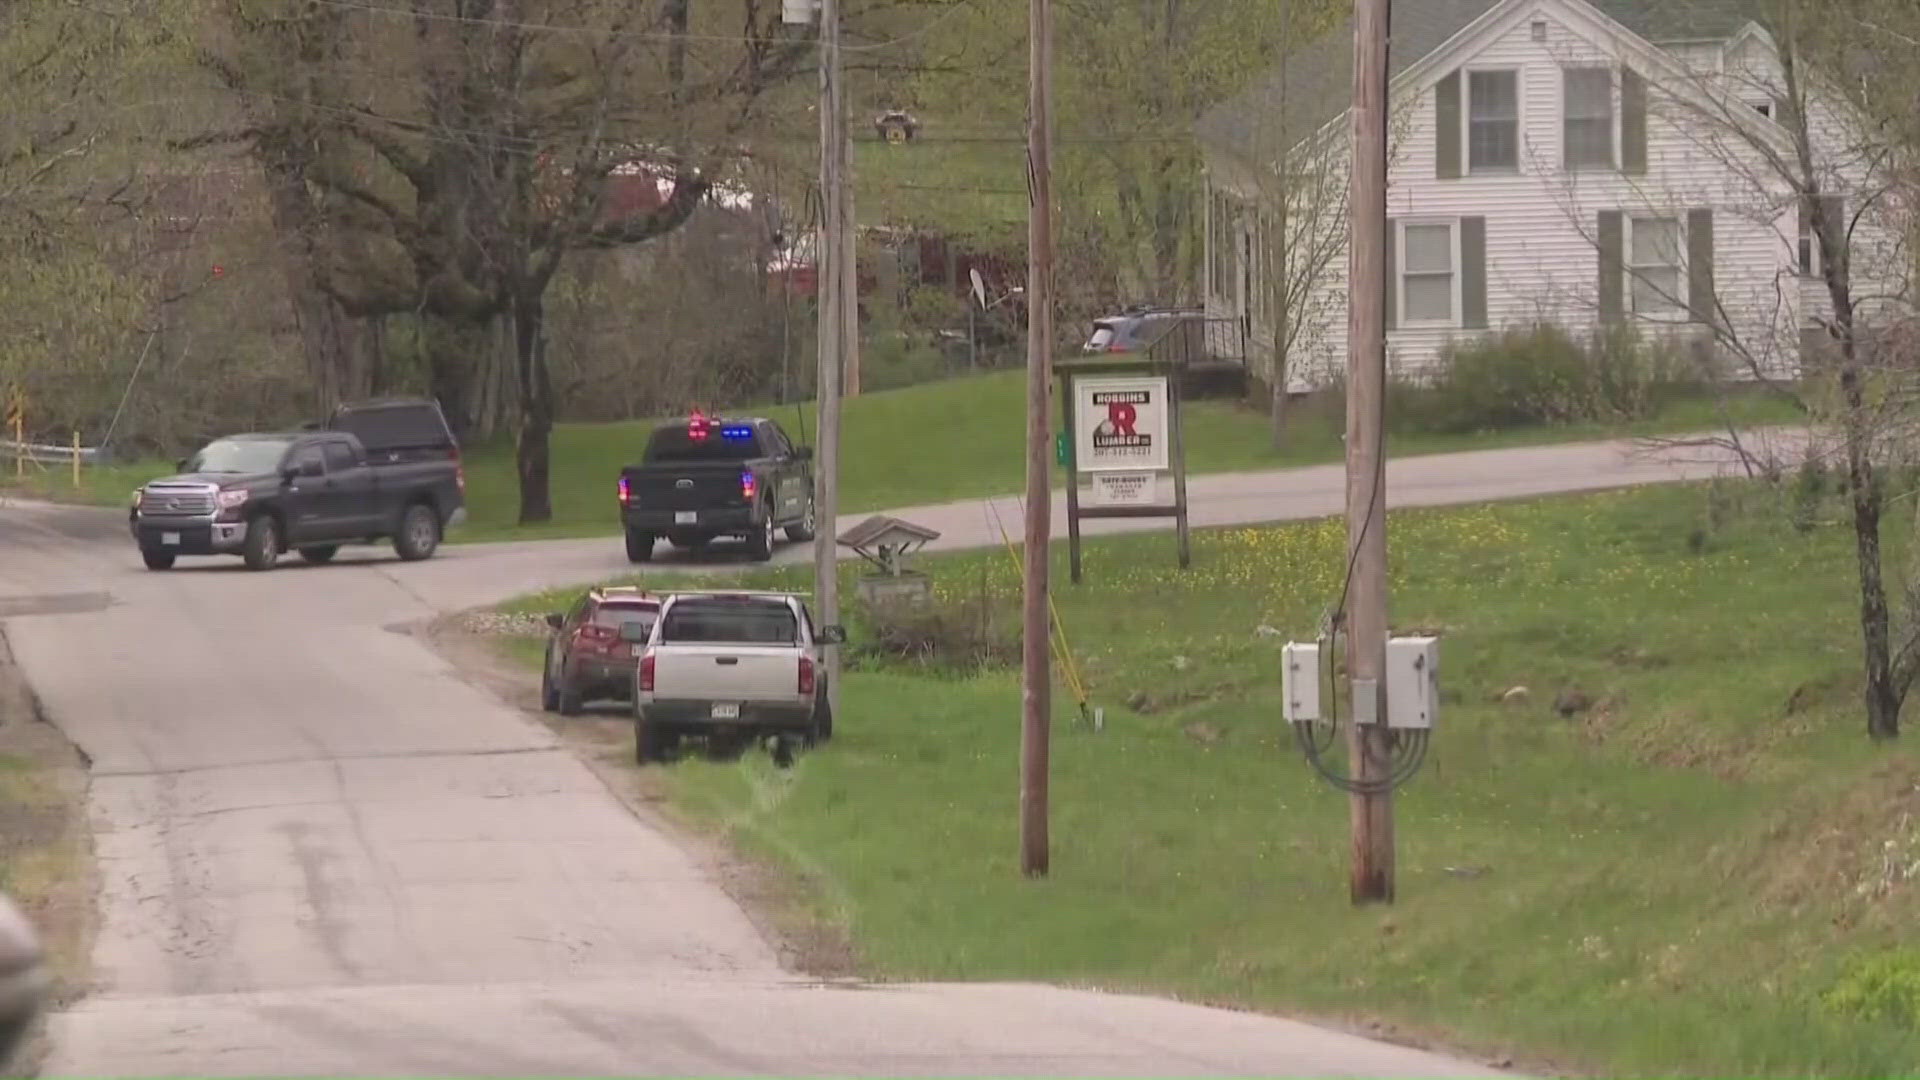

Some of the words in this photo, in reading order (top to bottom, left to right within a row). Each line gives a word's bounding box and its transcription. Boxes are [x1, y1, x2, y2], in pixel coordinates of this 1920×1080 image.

[1096, 391, 1146, 403] ROBBINS
[1108, 402, 1137, 436] R
[1095, 435, 1140, 446] LUMBER
